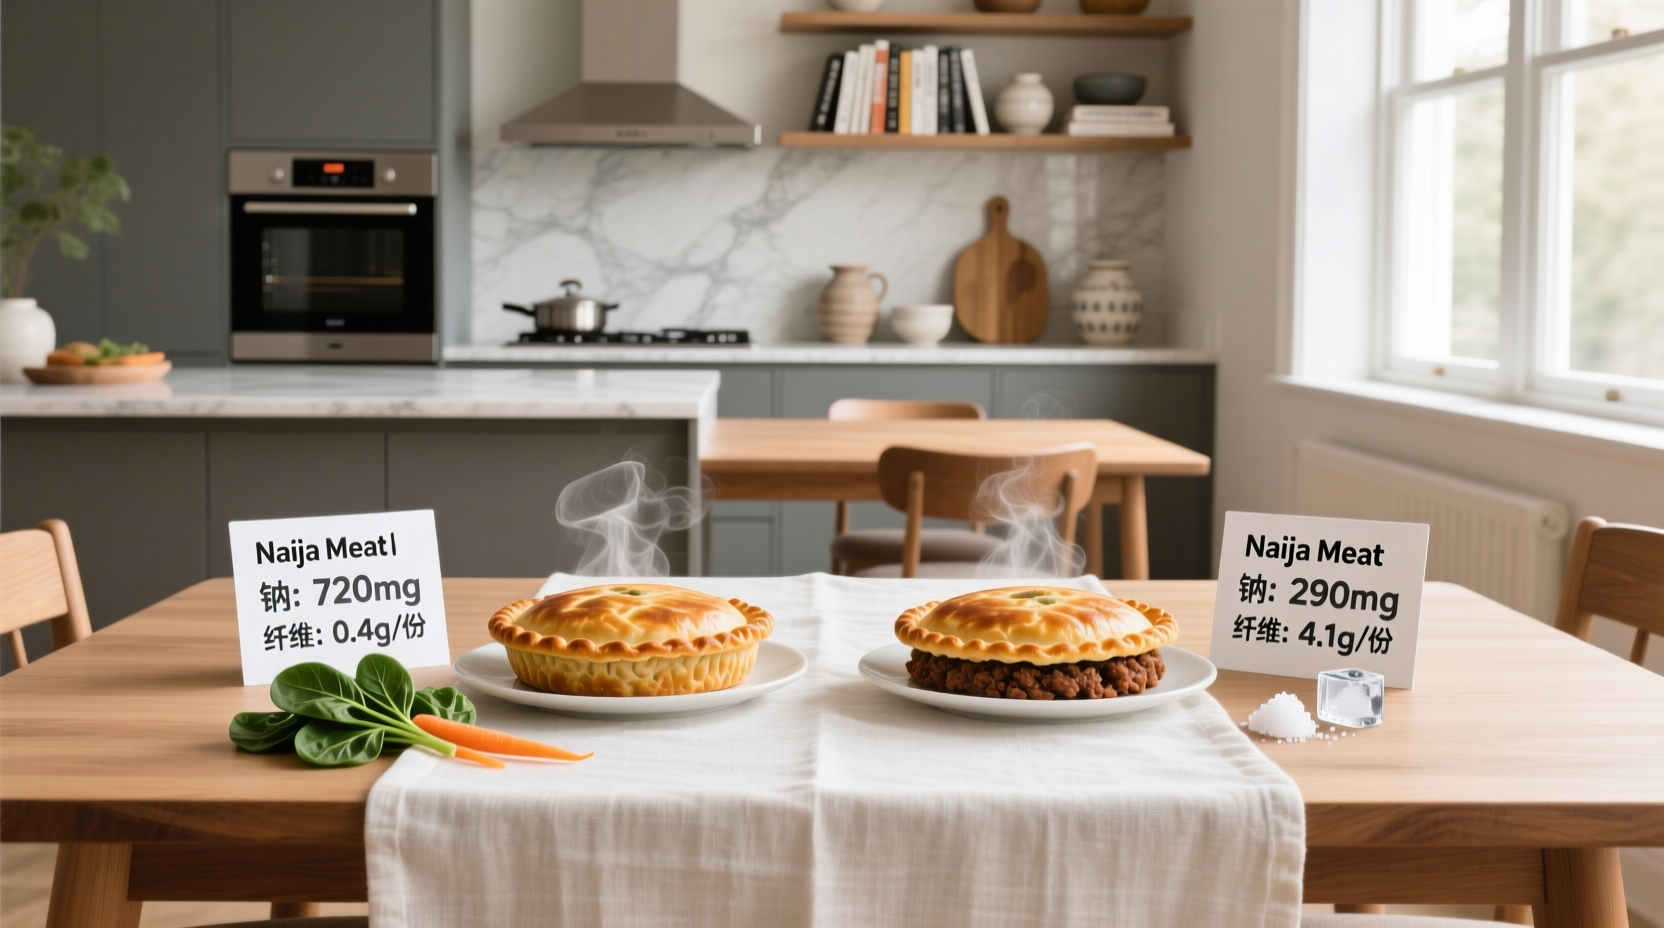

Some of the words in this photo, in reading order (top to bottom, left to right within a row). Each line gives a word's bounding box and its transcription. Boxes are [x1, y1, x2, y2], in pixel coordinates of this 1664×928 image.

[255, 538, 320, 569] Naija
[1245, 533, 1311, 568] Naija
[1316, 538, 1385, 567] Meat
